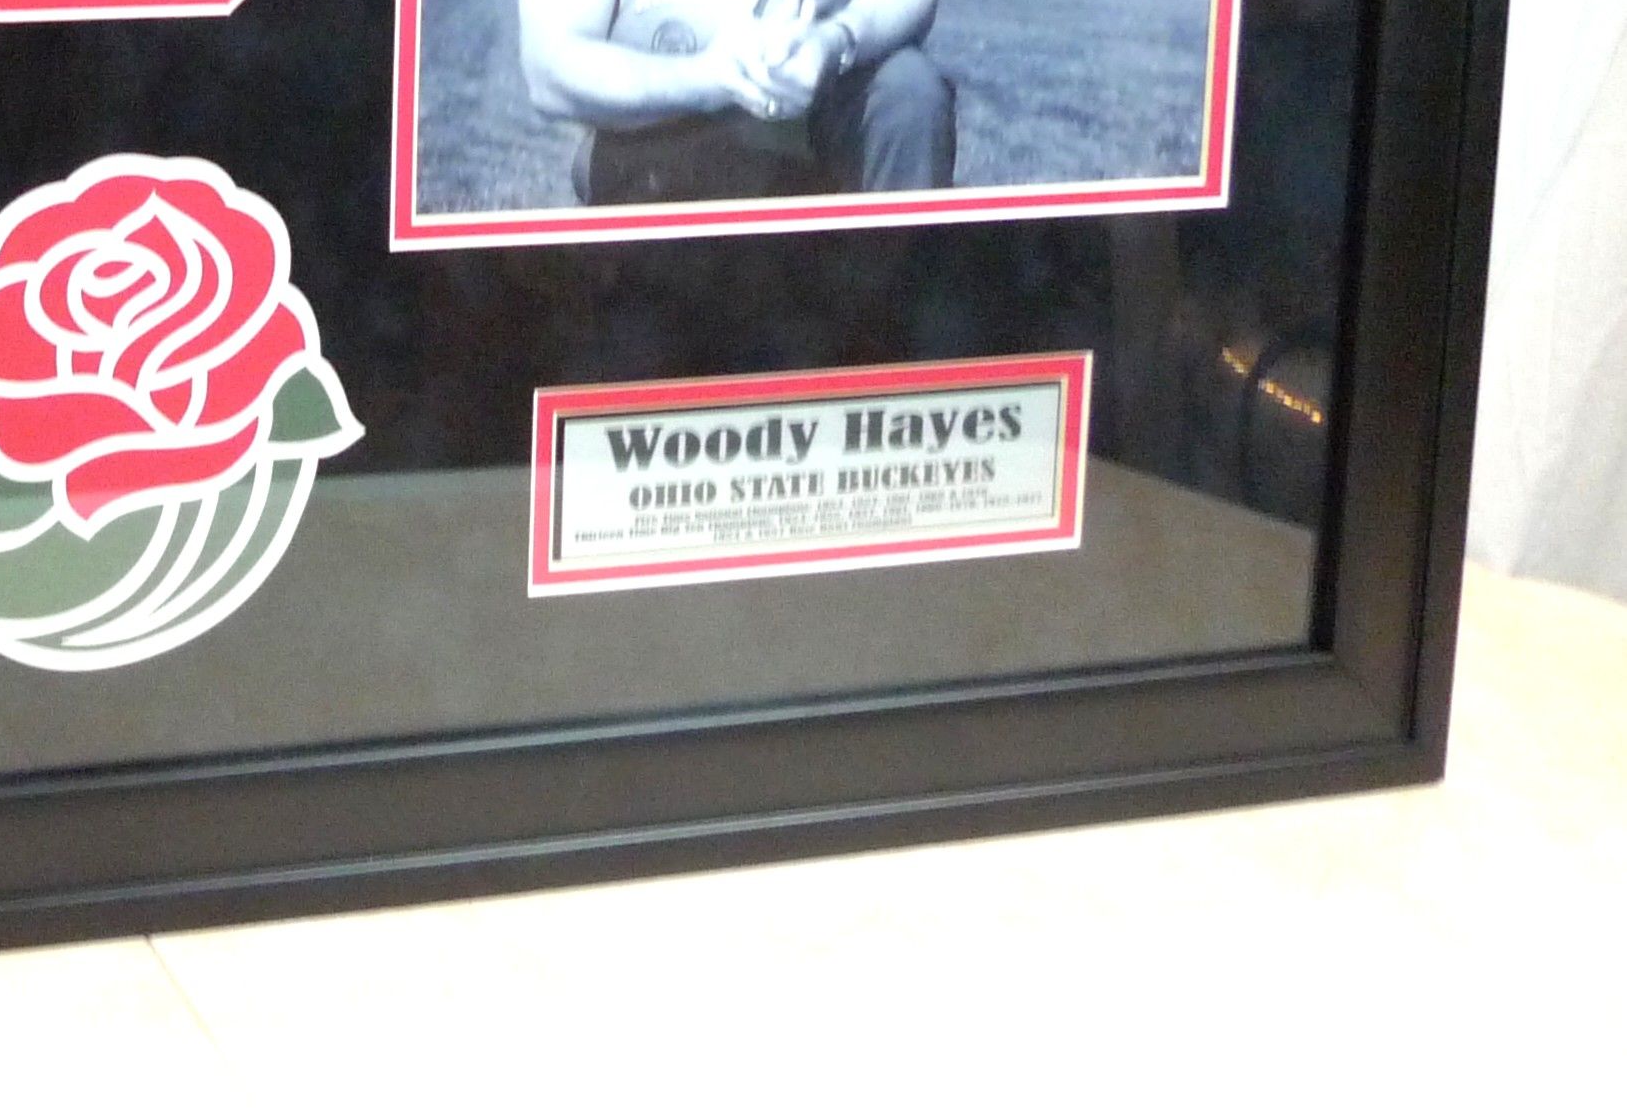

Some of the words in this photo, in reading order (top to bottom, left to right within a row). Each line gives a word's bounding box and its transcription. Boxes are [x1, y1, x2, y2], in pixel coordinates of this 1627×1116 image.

[605, 416, 820, 472] Woody
[843, 402, 1023, 455] Hayes
[629, 478, 717, 511] OHIO
[730, 469, 824, 500] STATE
[837, 456, 996, 495] BUCKEYES
